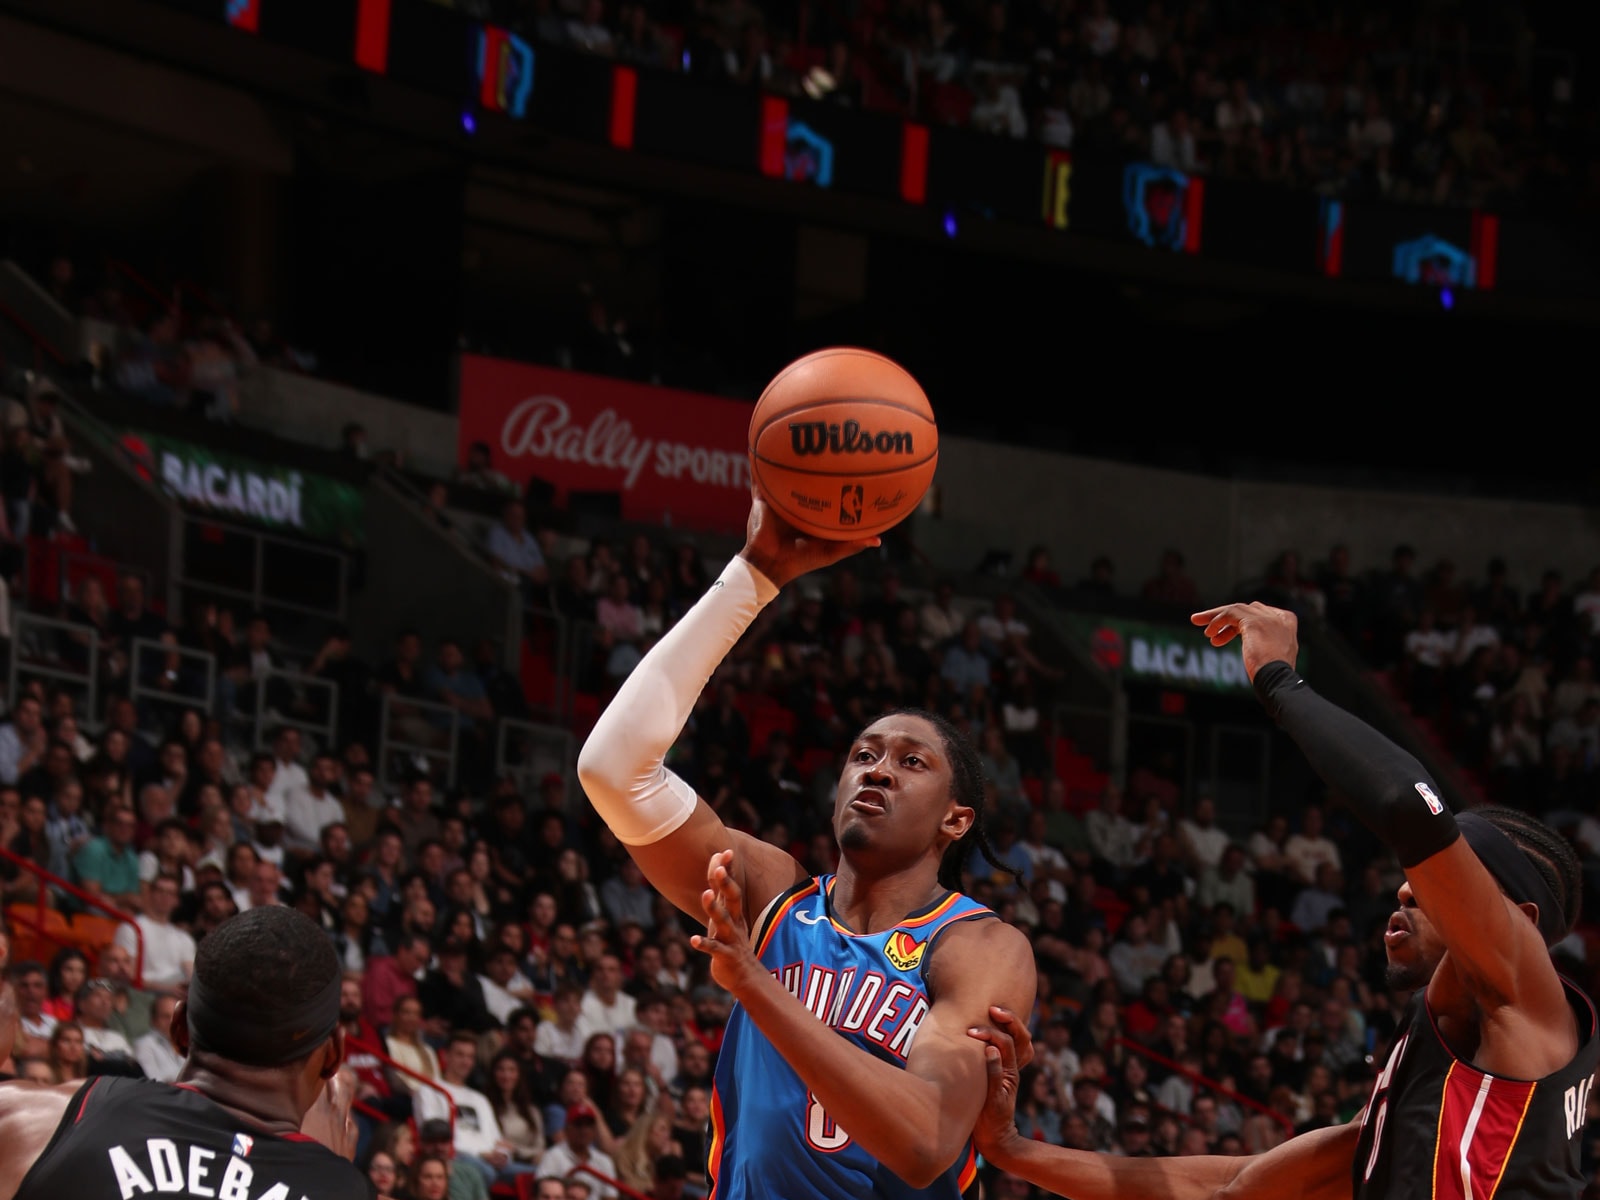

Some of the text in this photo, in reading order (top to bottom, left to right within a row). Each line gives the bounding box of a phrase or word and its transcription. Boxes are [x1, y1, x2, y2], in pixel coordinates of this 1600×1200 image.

[501, 395, 651, 490] Bally
[789, 419, 914, 455] Wilson
[770, 960, 929, 1062] HUNDER
